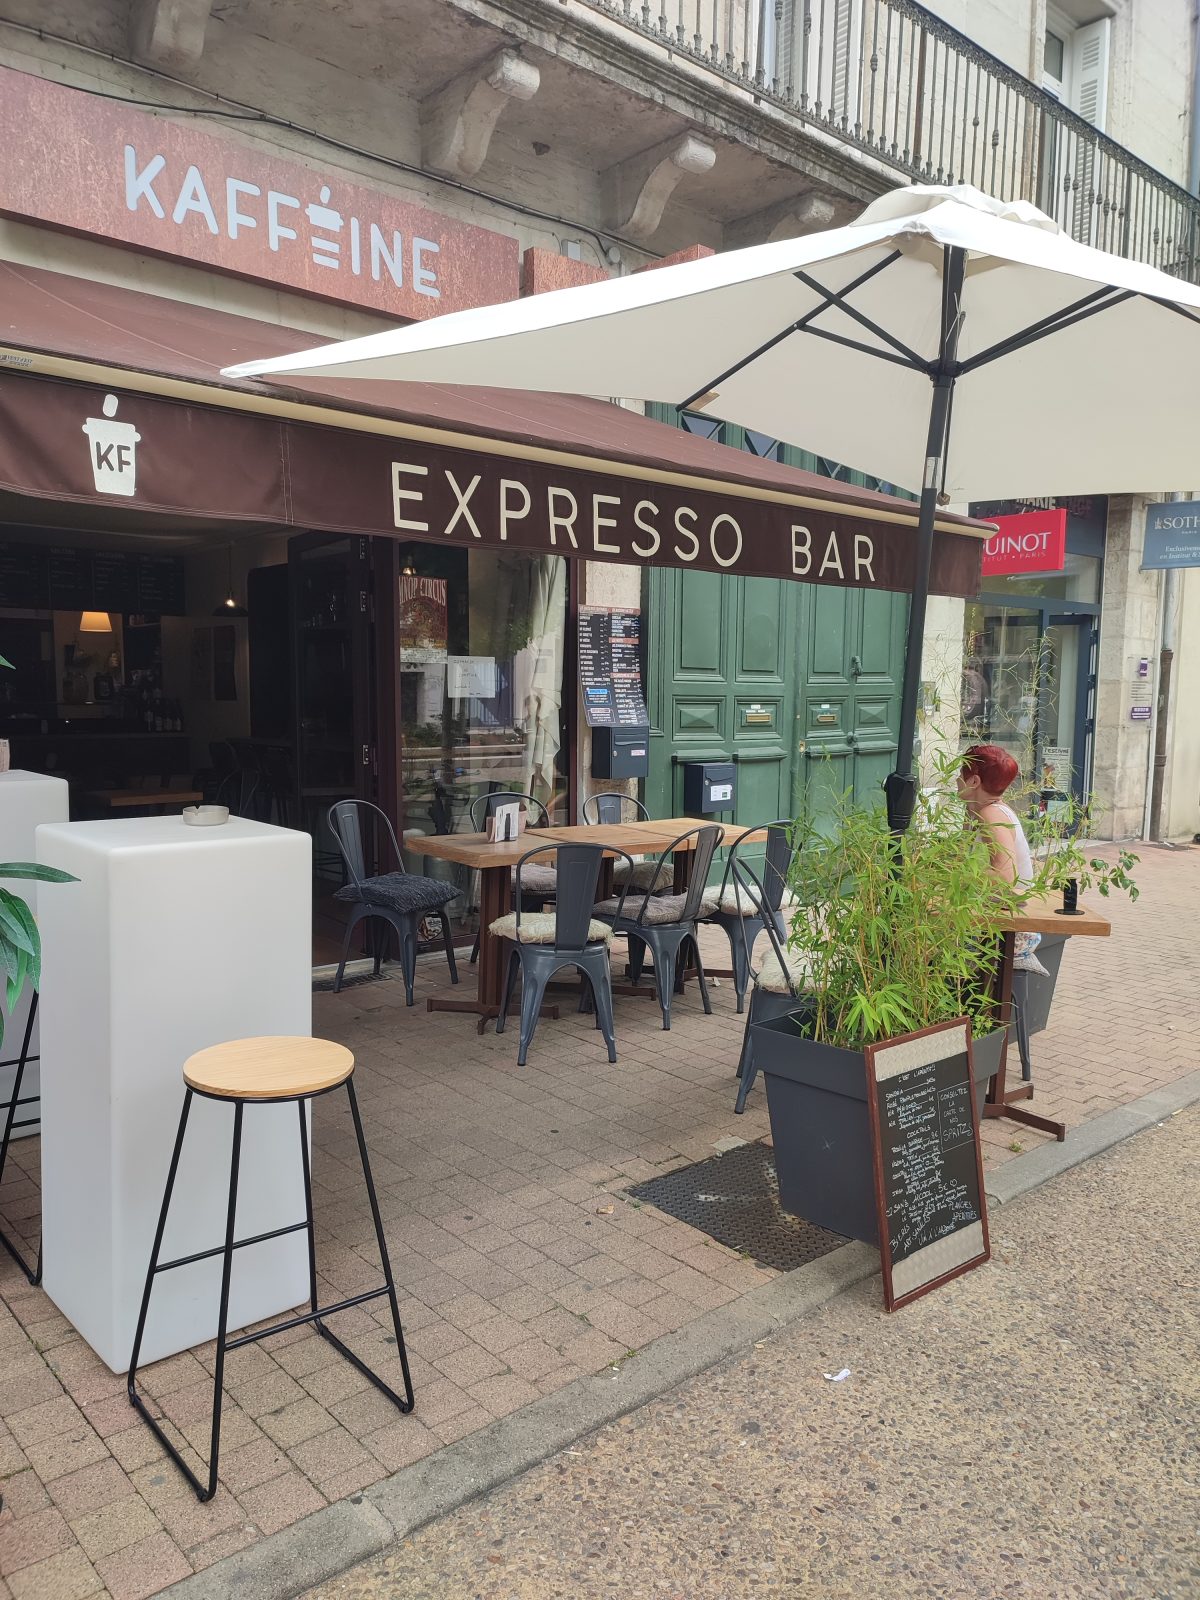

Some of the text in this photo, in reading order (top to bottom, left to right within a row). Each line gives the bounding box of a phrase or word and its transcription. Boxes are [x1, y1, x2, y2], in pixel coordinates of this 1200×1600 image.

[95, 440, 132, 473] KF
[391, 461, 877, 582] EXPRESSO BAR
[982, 531, 1052, 556] UINOT
[420, 577, 447, 607] CIRCUS
[940, 1087, 968, 1101] CONSULTEZ
